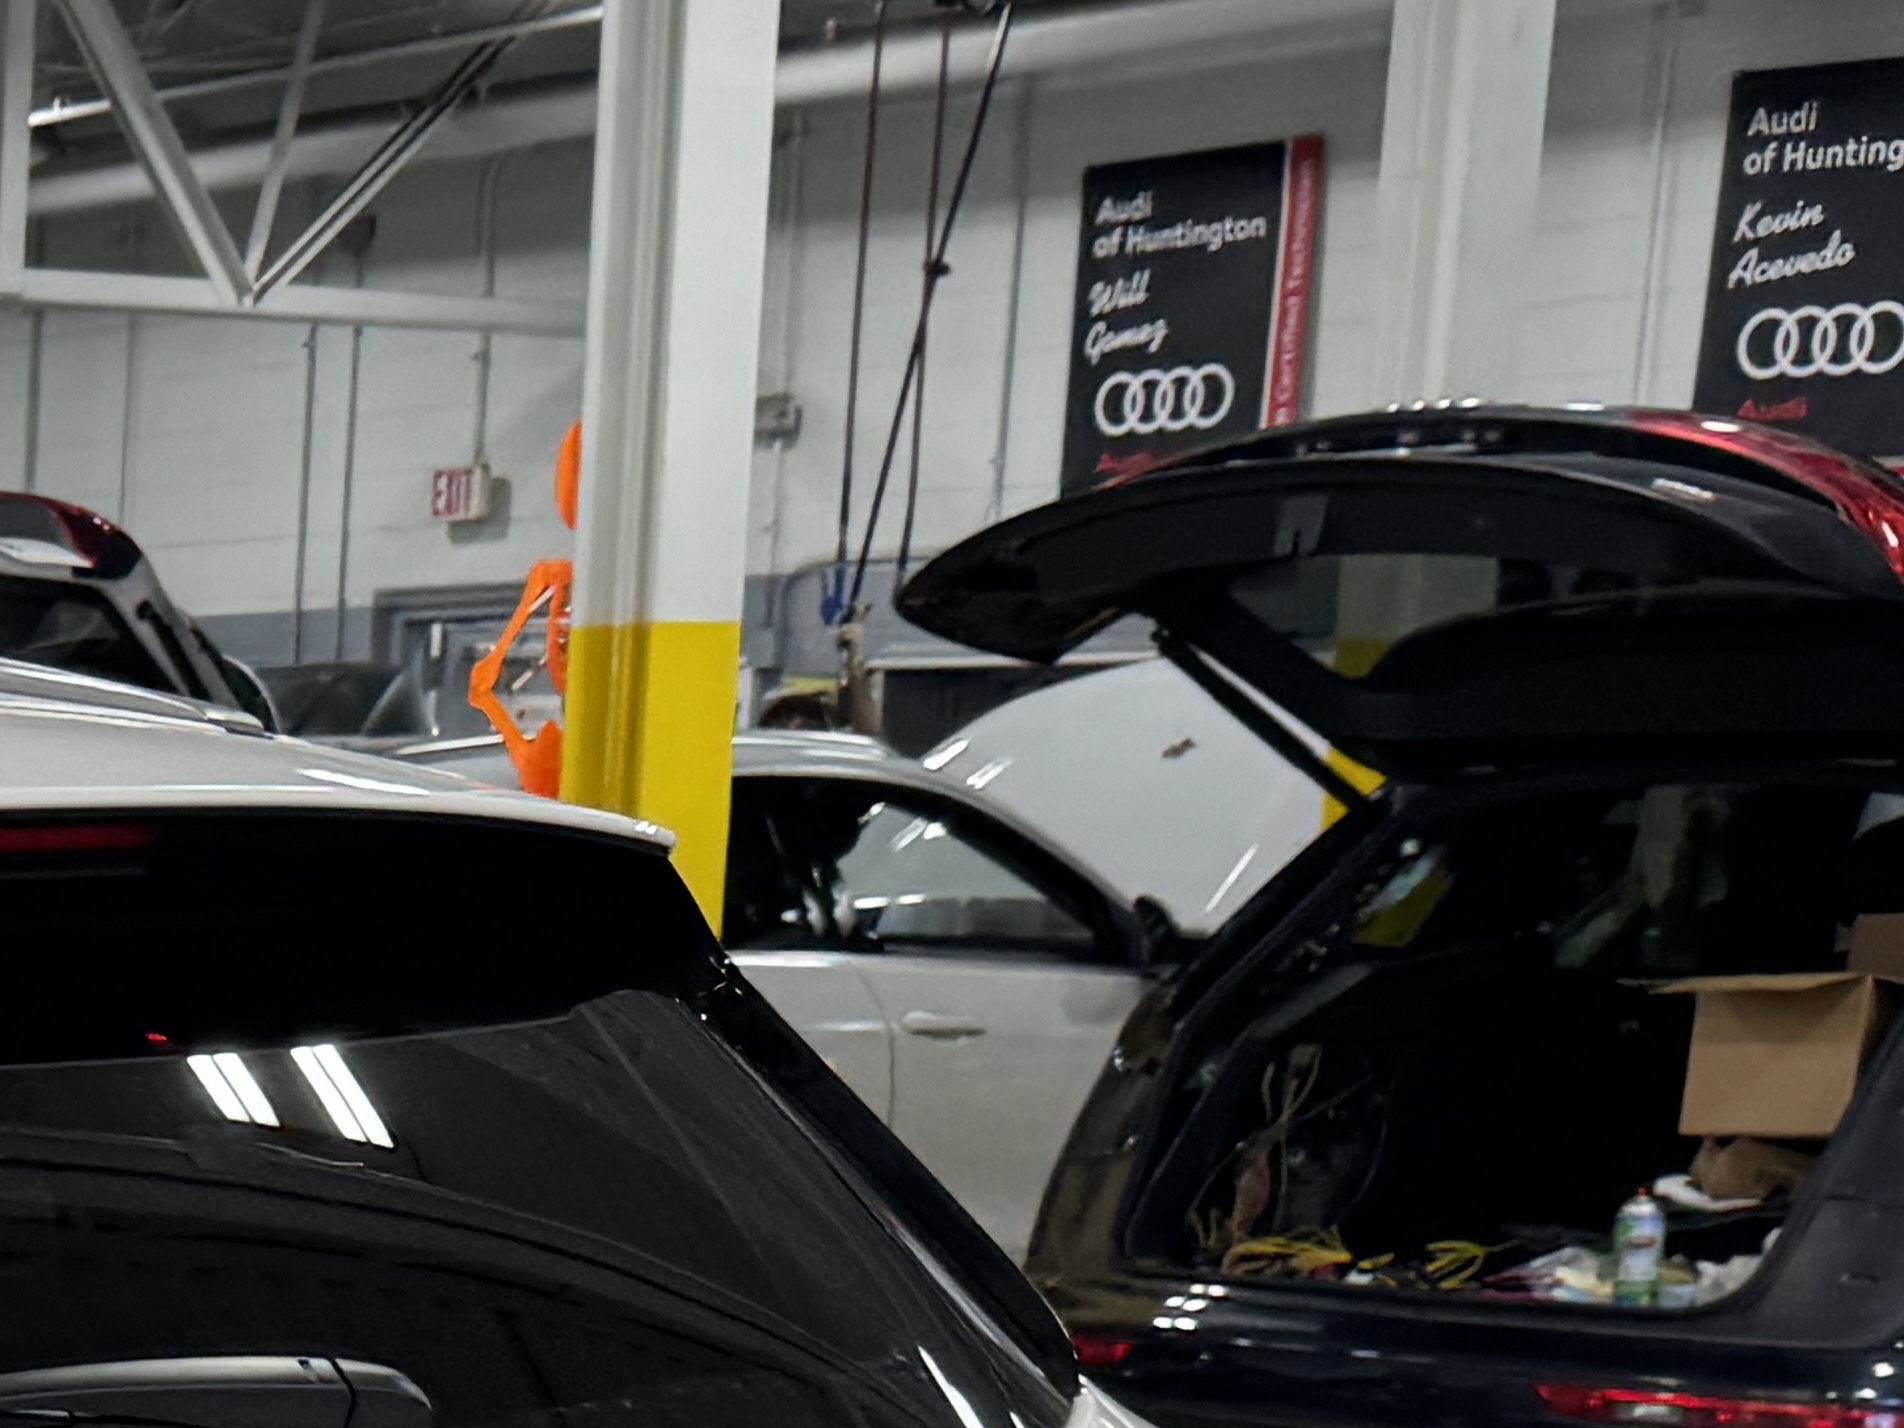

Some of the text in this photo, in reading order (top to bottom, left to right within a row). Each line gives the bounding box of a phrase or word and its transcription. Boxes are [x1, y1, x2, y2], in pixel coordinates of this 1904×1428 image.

[1747, 101, 1818, 136] Audi
[1743, 141, 1779, 175] of
[1095, 190, 1153, 224] Audi
[1734, 200, 1824, 243] Kevin
[1093, 215, 1267, 259] of Huntington
[1728, 229, 1856, 290] Acevedo
